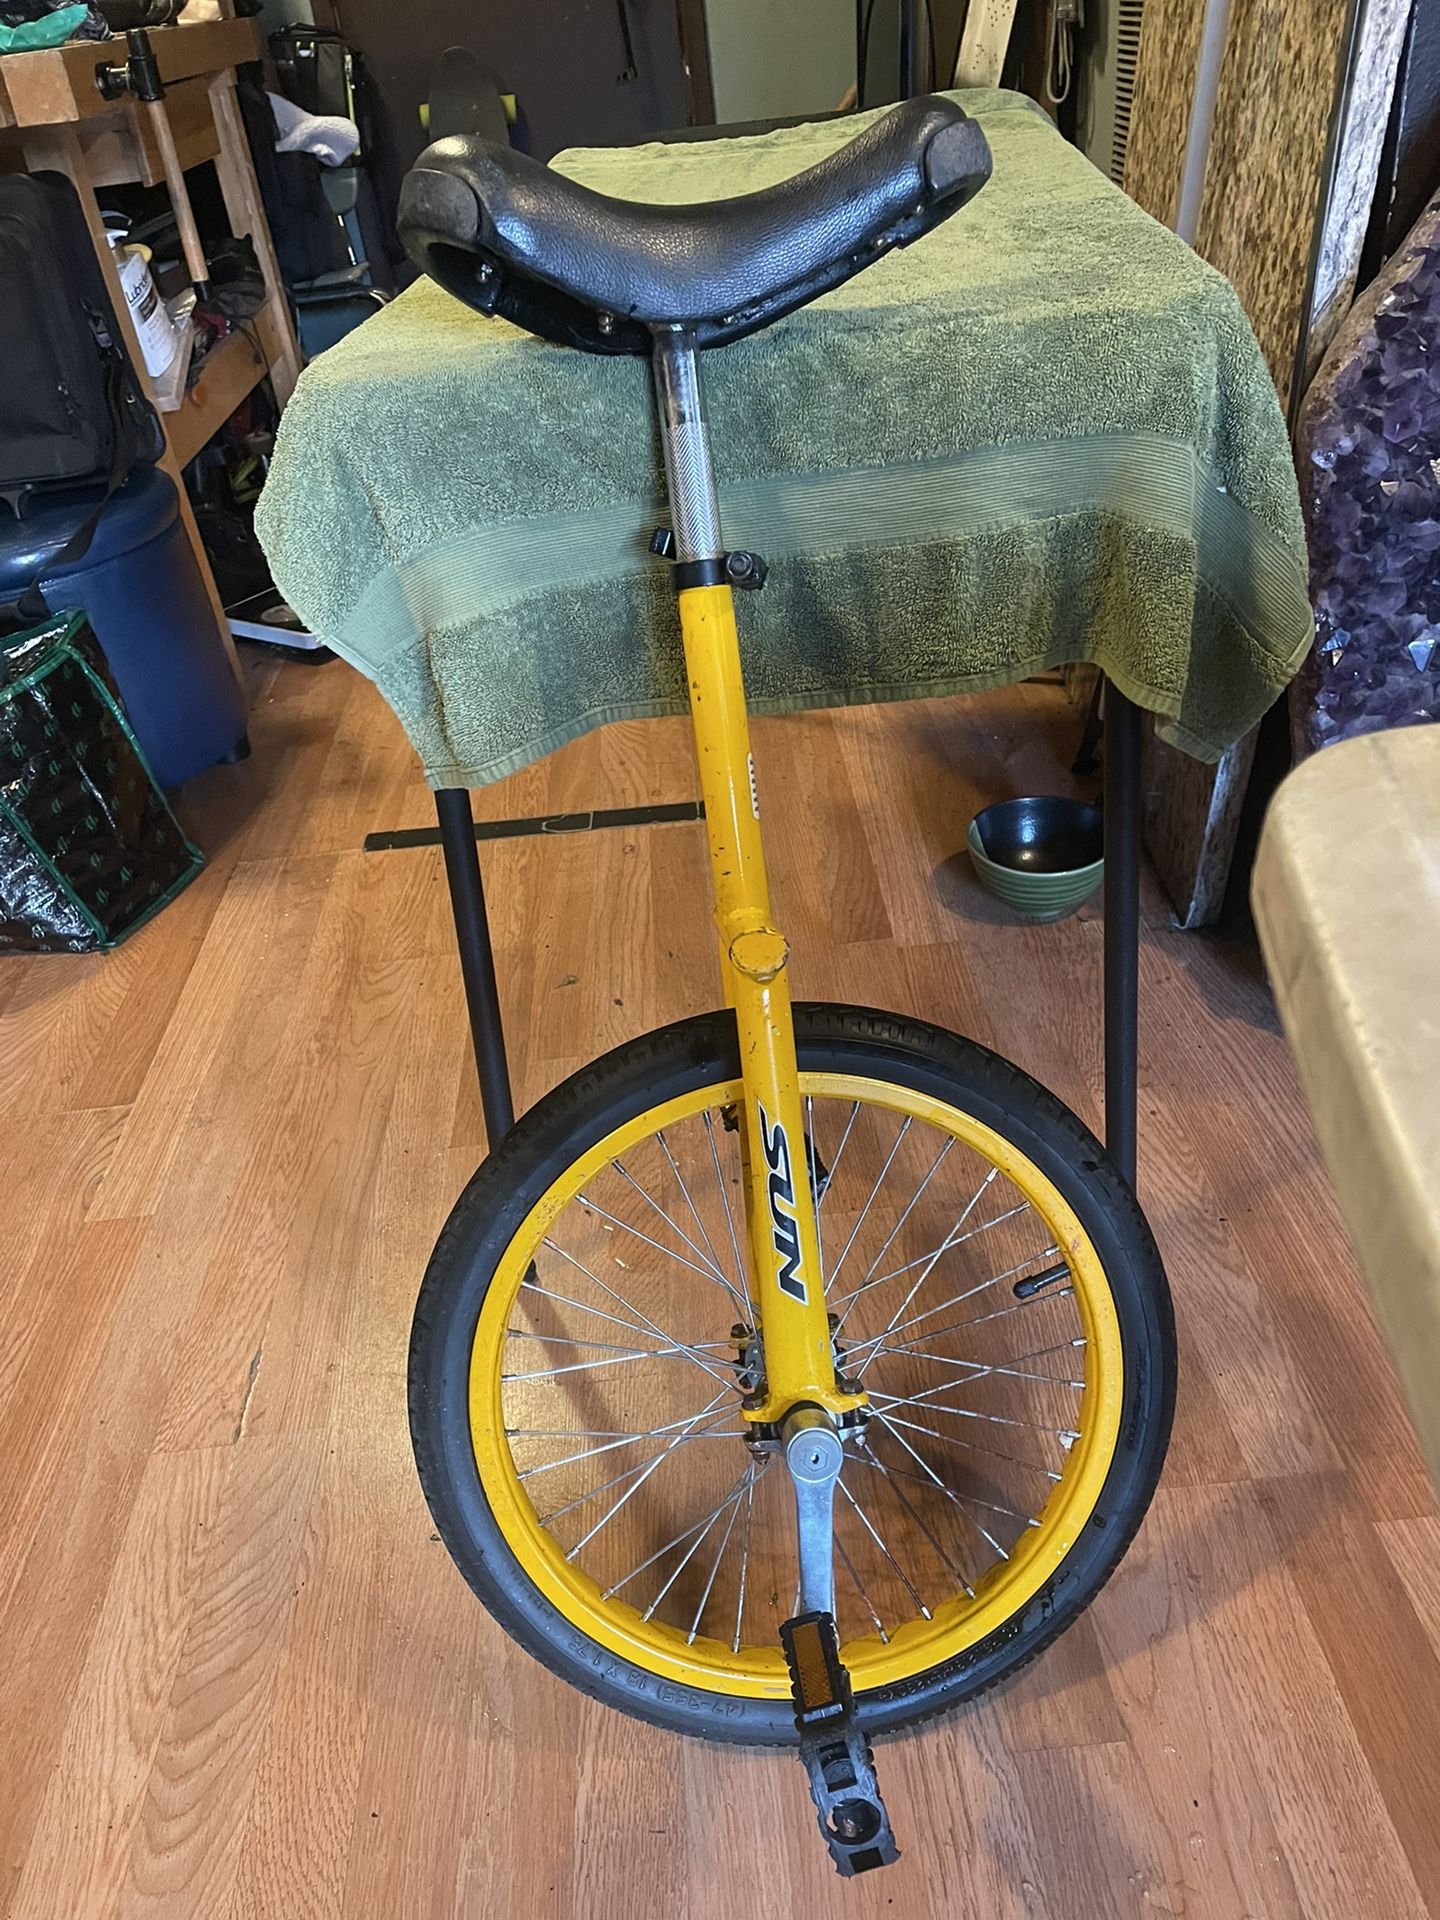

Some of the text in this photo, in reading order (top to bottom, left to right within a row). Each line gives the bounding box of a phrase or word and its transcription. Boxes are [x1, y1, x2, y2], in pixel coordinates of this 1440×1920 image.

[757, 1098, 809, 1305] SUN
[568, 1634, 601, 1666] 1.75
[628, 1671, 648, 1690] 18
[656, 1686, 746, 1718] (47-355)
